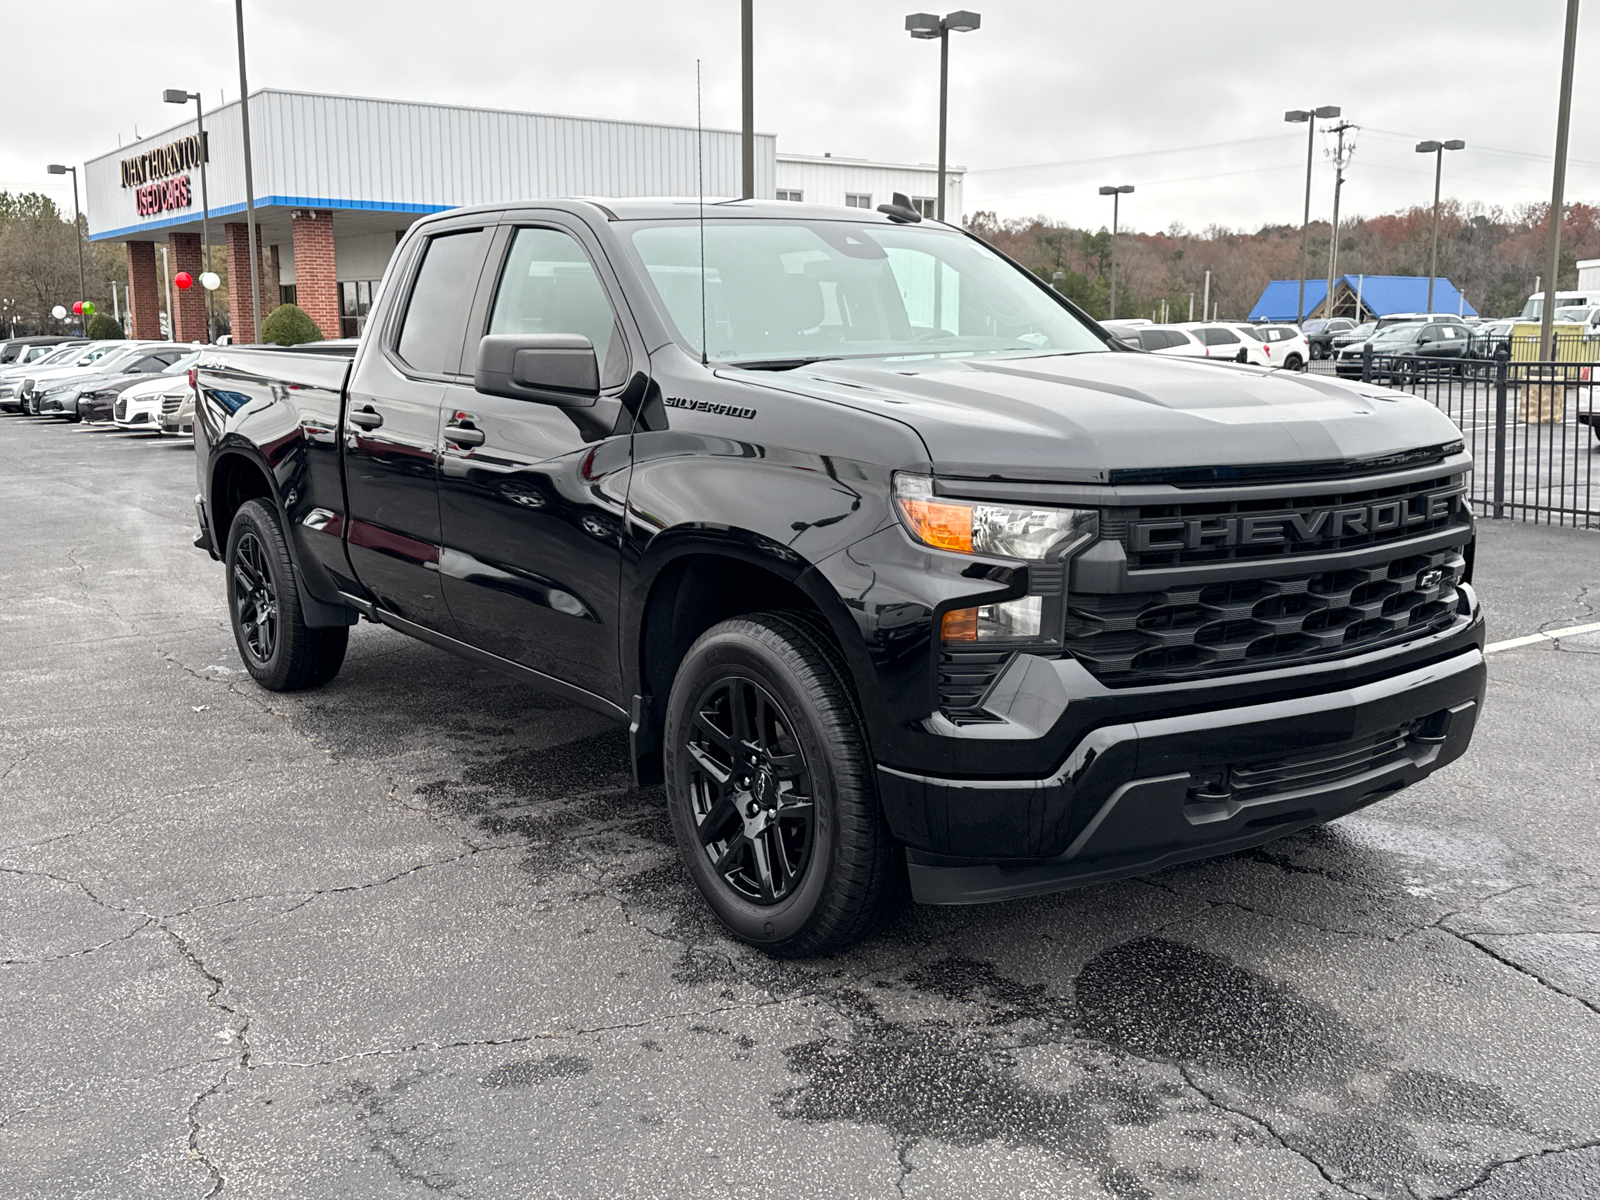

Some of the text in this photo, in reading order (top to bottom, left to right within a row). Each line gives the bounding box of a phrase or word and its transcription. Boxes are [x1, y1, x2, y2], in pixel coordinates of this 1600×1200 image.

[120, 154, 147, 188] JOHN
[135, 175, 190, 216] USED CARS
[664, 396, 757, 420] SILVERADO
[1129, 487, 1467, 549] CHEVROLET
